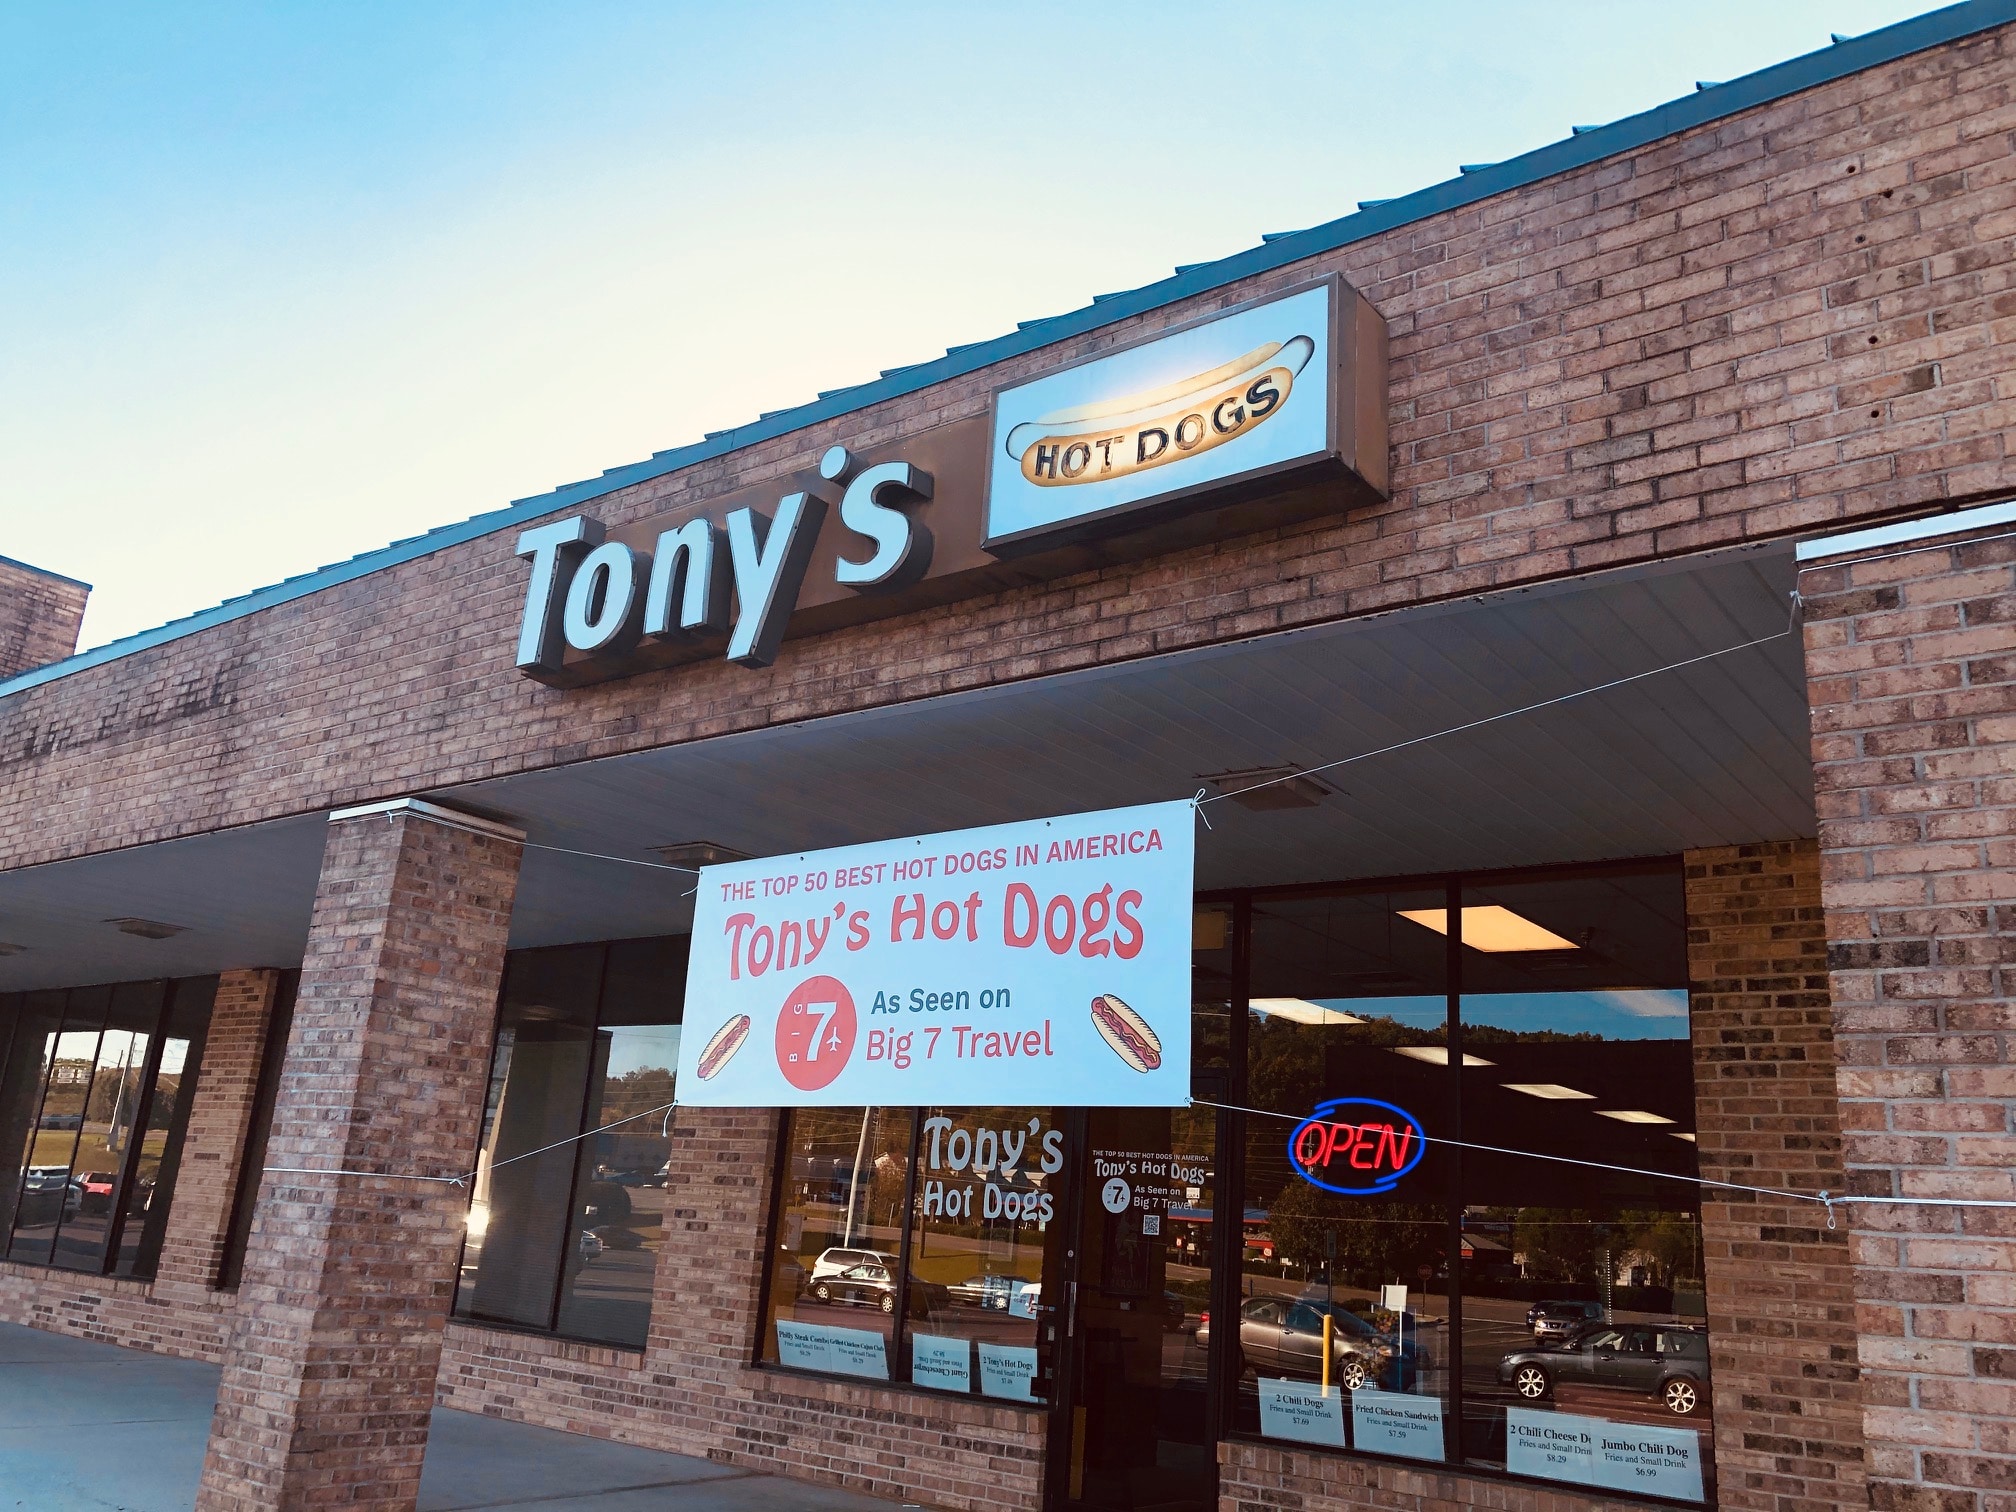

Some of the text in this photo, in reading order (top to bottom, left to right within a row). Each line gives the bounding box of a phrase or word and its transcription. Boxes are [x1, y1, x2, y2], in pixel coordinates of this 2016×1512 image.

[1034, 374, 1280, 480] HOT DOGS
[514, 445, 918, 668] Tony's
[720, 828, 1163, 902] THE TOP 50 BEST HOT DOGS IN AMERICA
[724, 882, 1144, 981] Tony's Hot Dogs
[870, 987, 1011, 1015] As Seen on
[806, 1001, 838, 1063] 7
[866, 1019, 1054, 1070] Big 7 Travel
[923, 1116, 1064, 1174] Tony's
[1295, 1122, 1413, 1170] OPEN
[1092, 1149, 1104, 1157] THE
[1125, 1151, 1141, 1159] BEST
[1173, 1153, 1181, 1161] IN
[1181, 1154, 1210, 1162] AMERICA
[1094, 1158, 1206, 1185] Tony's Hot Dogs
[1112, 1185, 1124, 1205] 7
[1134, 1184, 1181, 1196] As Seen on
[923, 1181, 1054, 1222] Hot Dogs
[1133, 1196, 1194, 1211] Big 7 Travel
[794, 1332, 809, 1342] Steak
[987, 1356, 1004, 1368] Tony's
[1004, 1359, 1017, 1369] Hot
[1017, 1360, 1033, 1370] Dogs
[951, 1369, 969, 1379] Giant
[1276, 1394, 1324, 1409] 2 Chili Dogs
[1269, 1404, 1332, 1419] Fries and Small Drink
[1355, 1404, 1439, 1422] Fried Chicken Sandwich
[1366, 1417, 1428, 1431] Fries and Small Drink
[1510, 1424, 1516, 1434] 2
[1518, 1425, 1541, 1438] Chili
[1544, 1429, 1578, 1442] Cheese
[1388, 1429, 1407, 1439] $7.59
[1519, 1439, 1536, 1448] Fries
[1537, 1441, 1550, 1450] and
[1552, 1442, 1573, 1453] Small
[1601, 1438, 1689, 1459] Jumbo Chili Dog
[1546, 1453, 1567, 1464] $8.29
[1604, 1452, 1687, 1469] Fries and Small Drink
[1635, 1466, 1657, 1478] $6.99
